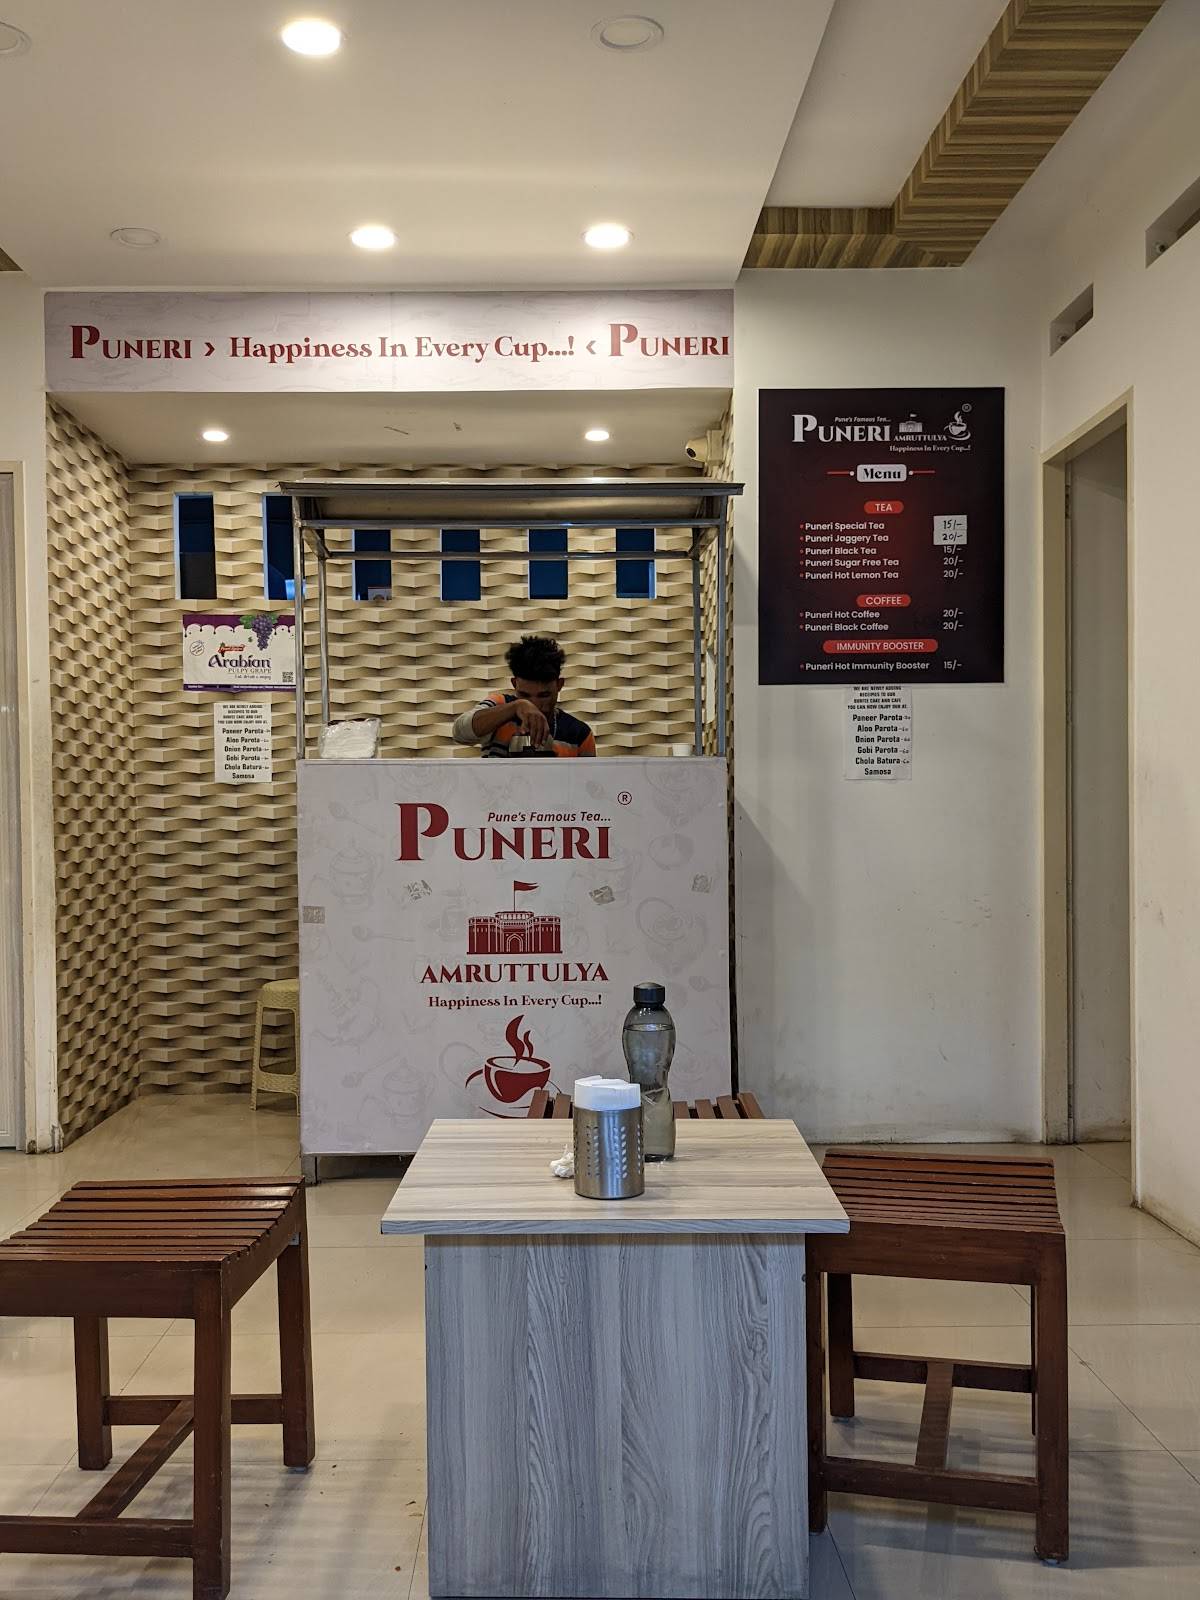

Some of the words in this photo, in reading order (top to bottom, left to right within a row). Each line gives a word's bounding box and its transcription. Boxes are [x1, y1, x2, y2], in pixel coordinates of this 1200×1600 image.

[70, 325, 192, 359] PUNERI
[229, 337, 373, 364] Happiness
[378, 336, 408, 358] In
[415, 336, 489, 363] Every
[608, 323, 730, 357] PUNERI
[792, 414, 891, 443] PUNERI
[893, 434, 947, 442] AMRUTTULYA
[889, 445, 923, 453] Happiness
[863, 468, 901, 479] Menu
[875, 503, 892, 512] TEA
[805, 522, 833, 530] Puneri
[835, 522, 867, 531] Special
[868, 522, 885, 530] Tea
[805, 534, 833, 542] Puneri
[835, 534, 871, 544] Jaggery
[873, 534, 889, 542] Tea
[805, 547, 833, 555] Puneri
[835, 547, 858, 555] Black
[805, 559, 833, 567] Puneri
[835, 559, 861, 568] Sugar
[862, 558, 881, 566] Free
[883, 558, 899, 566] Tea
[943, 555, 964, 566] 20/-
[805, 571, 833, 580] Puneri
[835, 571, 850, 579] Hot
[851, 571, 881, 579] Lemon
[882, 571, 899, 579] Tea
[943, 568, 964, 579] 20/-
[865, 596, 902, 605] COFFEE
[805, 611, 833, 619] Puneri
[834, 611, 850, 619] Hot
[851, 610, 880, 618] Coffee
[943, 608, 964, 619] 20/-
[805, 623, 833, 631] Puneri
[834, 623, 858, 631] Black
[860, 623, 889, 631] Coffee
[943, 620, 964, 631] 20/-
[836, 642, 881, 651] IMMUNITY
[883, 641, 924, 650] BOOSTER
[208, 654, 271, 668] Arabian
[805, 662, 833, 671] Puneri
[835, 662, 850, 671] Hot
[851, 662, 894, 672] Immunity
[896, 661, 930, 670] Booster
[944, 659, 962, 670] 15/-
[487, 812, 527, 822] Pune's
[530, 811, 576, 822] Famous
[580, 811, 611, 822] Tea...
[394, 802, 613, 861] PUNERI
[420, 962, 609, 983] AMRUTTULYA
[429, 996, 501, 1009] Happiness
[504, 996, 518, 1006] In
[522, 995, 559, 1009] Every
